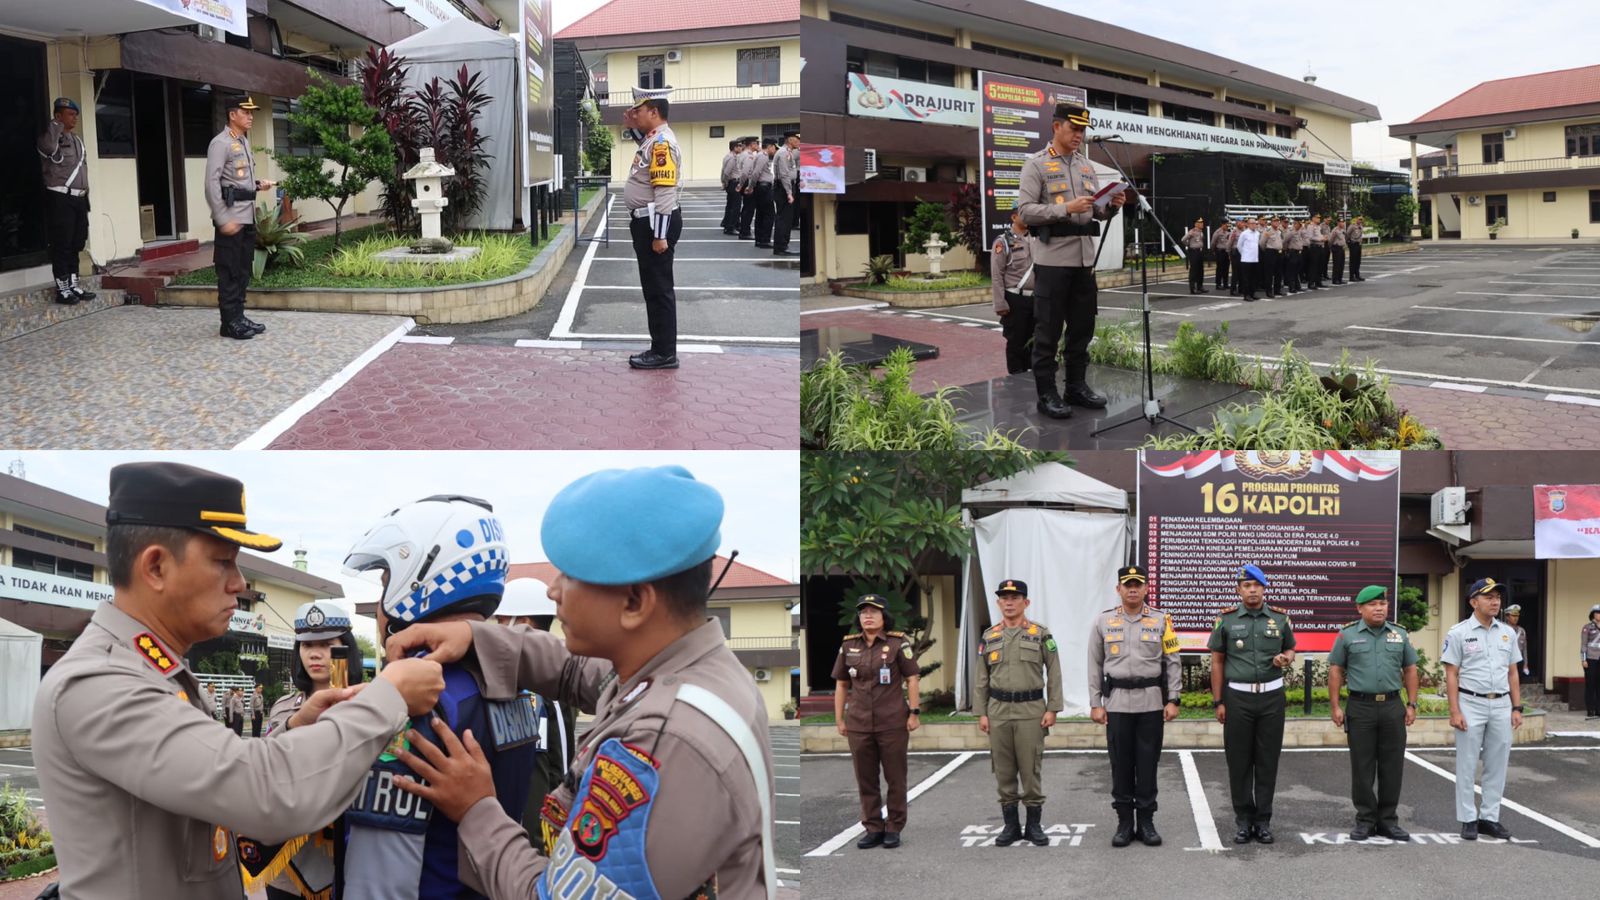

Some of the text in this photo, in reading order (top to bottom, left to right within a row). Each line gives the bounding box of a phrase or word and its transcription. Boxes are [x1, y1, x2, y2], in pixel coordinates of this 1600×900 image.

[989, 84, 997, 98] 5
[904, 93, 975, 113] PRAJURIT
[1091, 118, 1112, 130] DAK
[1116, 122, 1142, 133] AKAN
[1146, 125, 1208, 142] MENGKHIANATI
[1210, 134, 1238, 146] NEGARA
[1240, 139, 1254, 148] DAN
[1200, 482, 1240, 514] 16
[1242, 482, 1340, 494] PROGRAM PRIORITAS
[1242, 494, 1340, 516] KAPOLRI
[11, 576, 47, 592] TIDAK
[52, 584, 82, 598] AKAN
[488, 698, 538, 746] DISHUB
[352, 770, 428, 820] TROL
